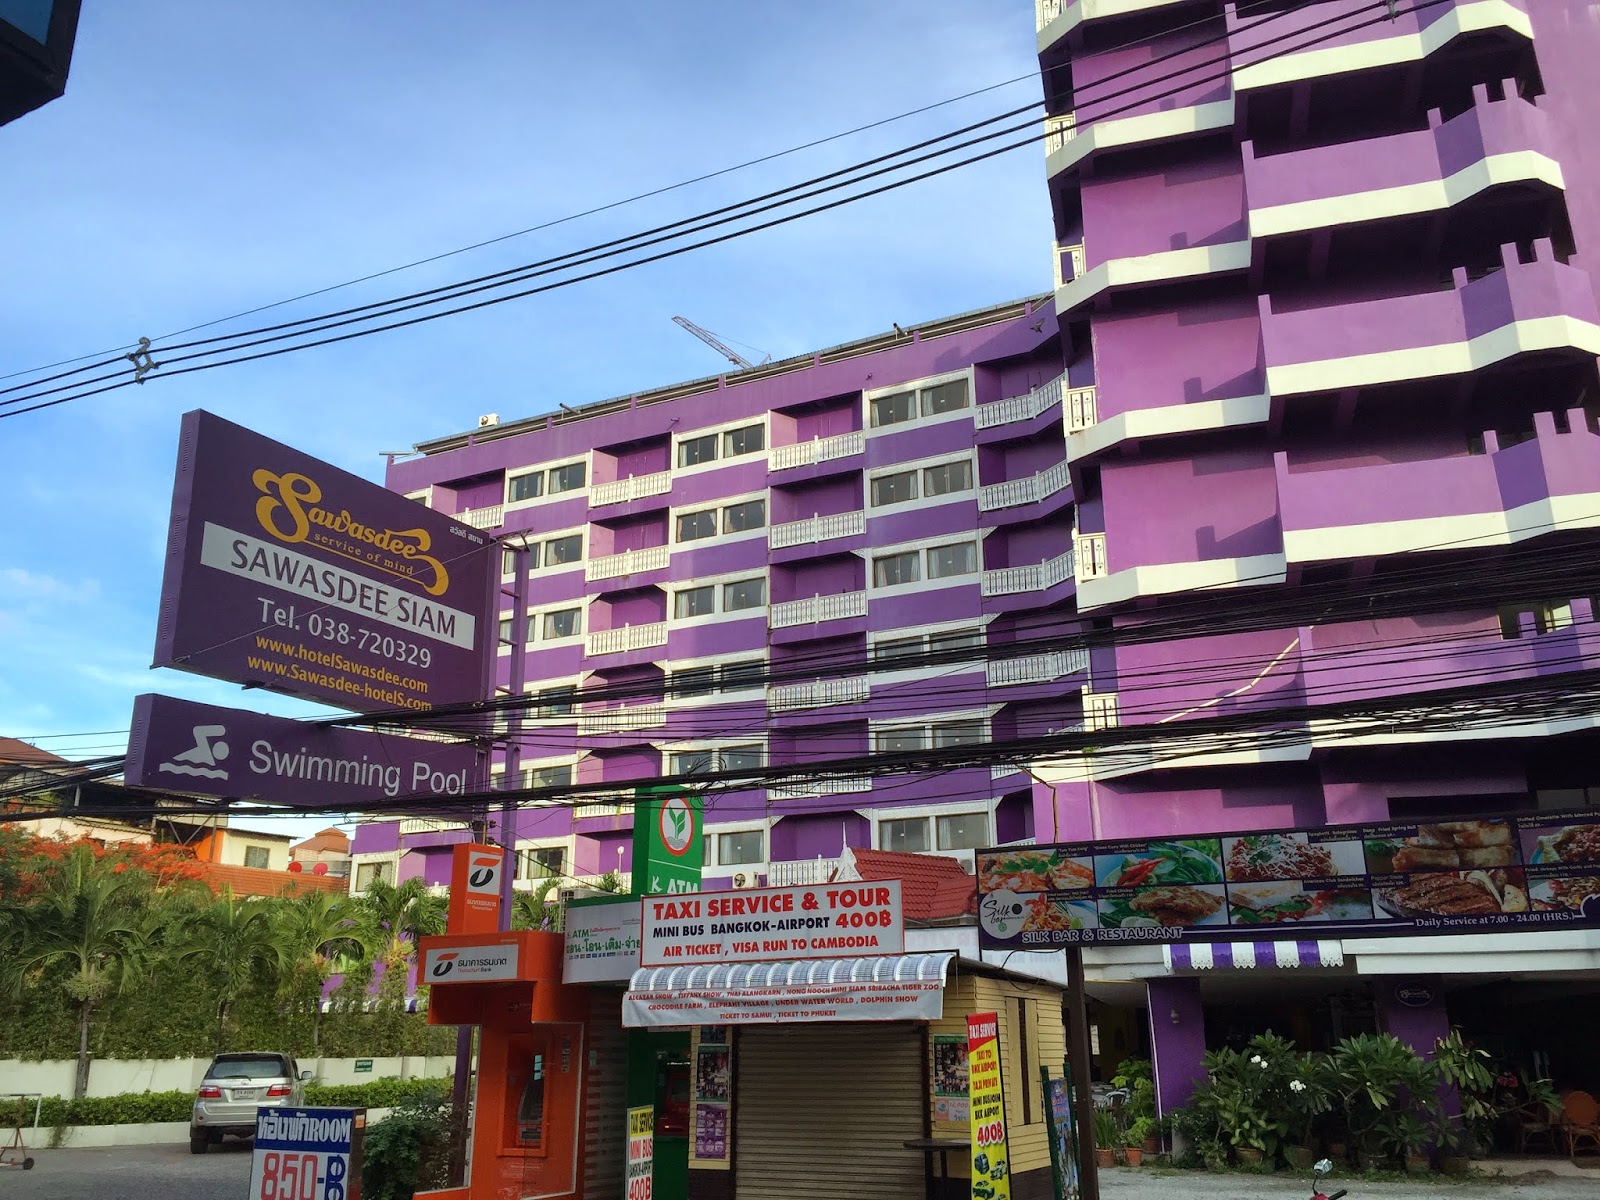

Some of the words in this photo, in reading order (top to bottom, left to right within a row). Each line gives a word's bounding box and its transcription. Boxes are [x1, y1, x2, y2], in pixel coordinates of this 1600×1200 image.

[252, 468, 449, 596] Sawasdee
[313, 532, 362, 556] service
[366, 553, 382, 562] of
[384, 559, 414, 576] mind
[231, 539, 388, 616] SAWASDEE
[397, 596, 456, 638] SIAM
[258, 597, 300, 630] Tel.
[308, 613, 432, 669] 038-720329
[256, 635, 429, 694] www.hotelSawasdee.com
[248, 655, 432, 712] www.Sawasdee-hotelS.com
[249, 740, 401, 797] Swimming
[412, 761, 467, 796] Pool
[667, 879, 698, 894] ATM
[653, 900, 701, 921] TAXI
[707, 893, 794, 917] SERVICE
[801, 892, 819, 911] &
[826, 887, 891, 909] TOUR
[652, 926, 679, 938] MINI
[682, 924, 704, 936] BUS
[711, 916, 830, 935] BANGKOK-AIRPORT
[1415, 917, 1441, 929] Daily
[1443, 916, 1477, 926] Service
[1479, 916, 1488, 924] at
[1490, 915, 1508, 923] 7.00
[1517, 914, 1540, 922] 24.00
[1542, 912, 1575, 922] (HRS.)
[572, 929, 589, 938] ATM
[1022, 930, 1050, 943] SILK
[1053, 930, 1080, 942] BAR
[1082, 930, 1094, 941] &
[1098, 926, 1183, 941] RESTAURANT
[663, 946, 683, 957] AIR
[685, 943, 722, 956] TICKET
[732, 941, 759, 953] VISA
[763, 939, 788, 952] RUN
[791, 938, 807, 950] TO
[811, 935, 879, 949] CAMBODIA
[628, 993, 654, 1001] ALCAZAR
[741, 989, 781, 997] ALANGKARN
[969, 1023, 980, 1039] TAXI
[980, 1022, 997, 1038] SERVICE
[976, 1050, 985, 1061] TAXI
[985, 1049, 992, 1060] TO
[972, 1079, 982, 1091] TAXI
[630, 1140, 640, 1160] MINI
[642, 1138, 652, 1158] BUS
